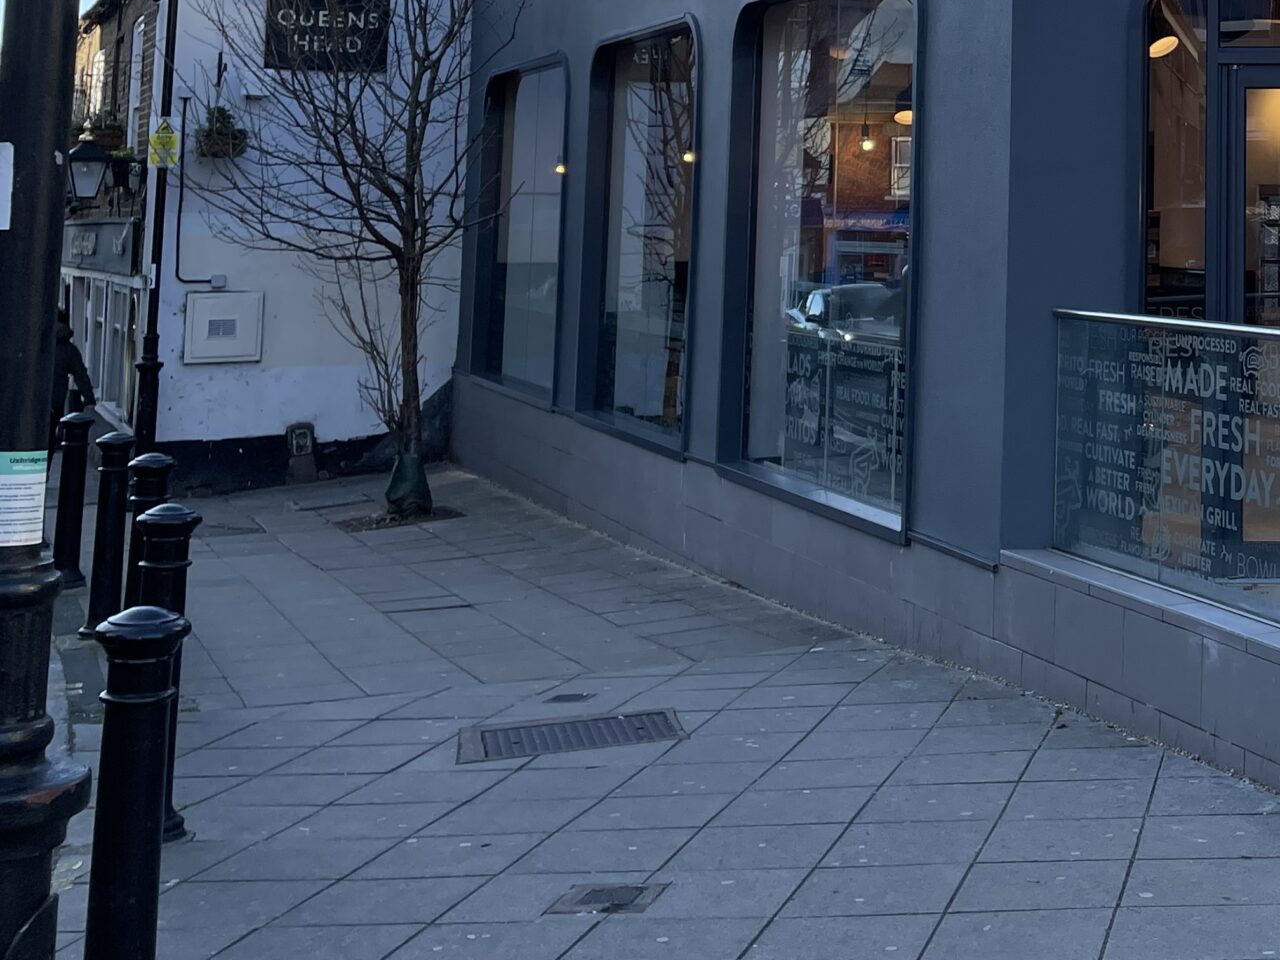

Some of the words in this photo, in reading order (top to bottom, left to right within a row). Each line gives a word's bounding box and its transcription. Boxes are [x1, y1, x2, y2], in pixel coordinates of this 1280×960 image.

[277, 6, 380, 29] QUEENS
[296, 34, 362, 53] HEAD
[1165, 359, 1229, 401] MADE
[1229, 377, 1253, 395] REAL
[1100, 391, 1137, 416] FRESH
[1239, 398, 1261, 416] REAL
[1071, 418, 1094, 437] REAL
[1190, 408, 1261, 456] FRESH
[1085, 442, 1136, 469] CULTIVATE
[1095, 467, 1130, 491] BETTER
[1163, 448, 1276, 507] EVERYDAY
[1086, 487, 1135, 521] WORLD
[1206, 506, 1238, 532] GRILL
